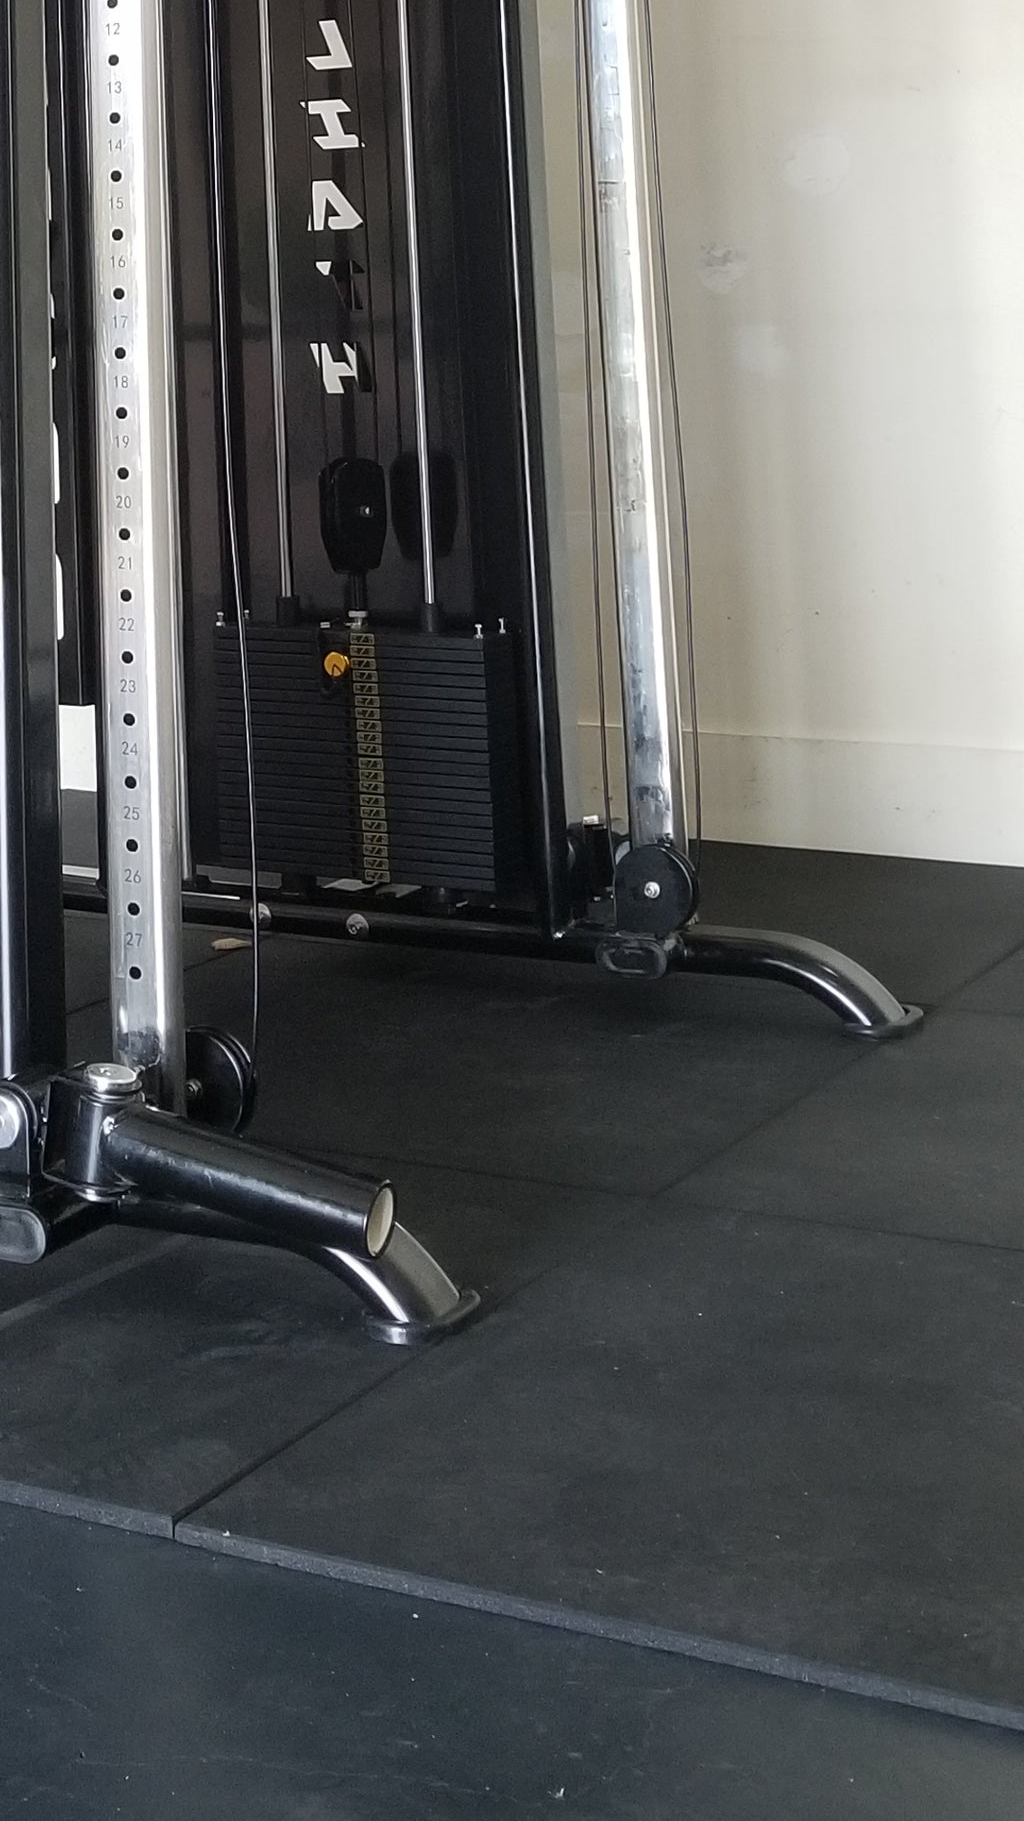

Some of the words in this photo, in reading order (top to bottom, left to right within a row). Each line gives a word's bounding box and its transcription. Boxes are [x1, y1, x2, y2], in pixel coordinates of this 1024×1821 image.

[105, 23, 120, 36] 12
[107, 81, 122, 94] 13
[107, 139, 123, 152] 14
[108, 197, 124, 210] 15
[110, 255, 126, 268] 16
[112, 316, 128, 329] 17
[113, 375, 129, 389] 18
[114, 435, 130, 449] 19
[115, 495, 132, 509] 20
[117, 556, 133, 570] 21
[118, 617, 135, 632] 22
[119, 679, 137, 693] 23
[121, 741, 139, 756] 24
[123, 806, 140, 821] 25
[124, 869, 142, 884] 26
[126, 932, 143, 947] 27
